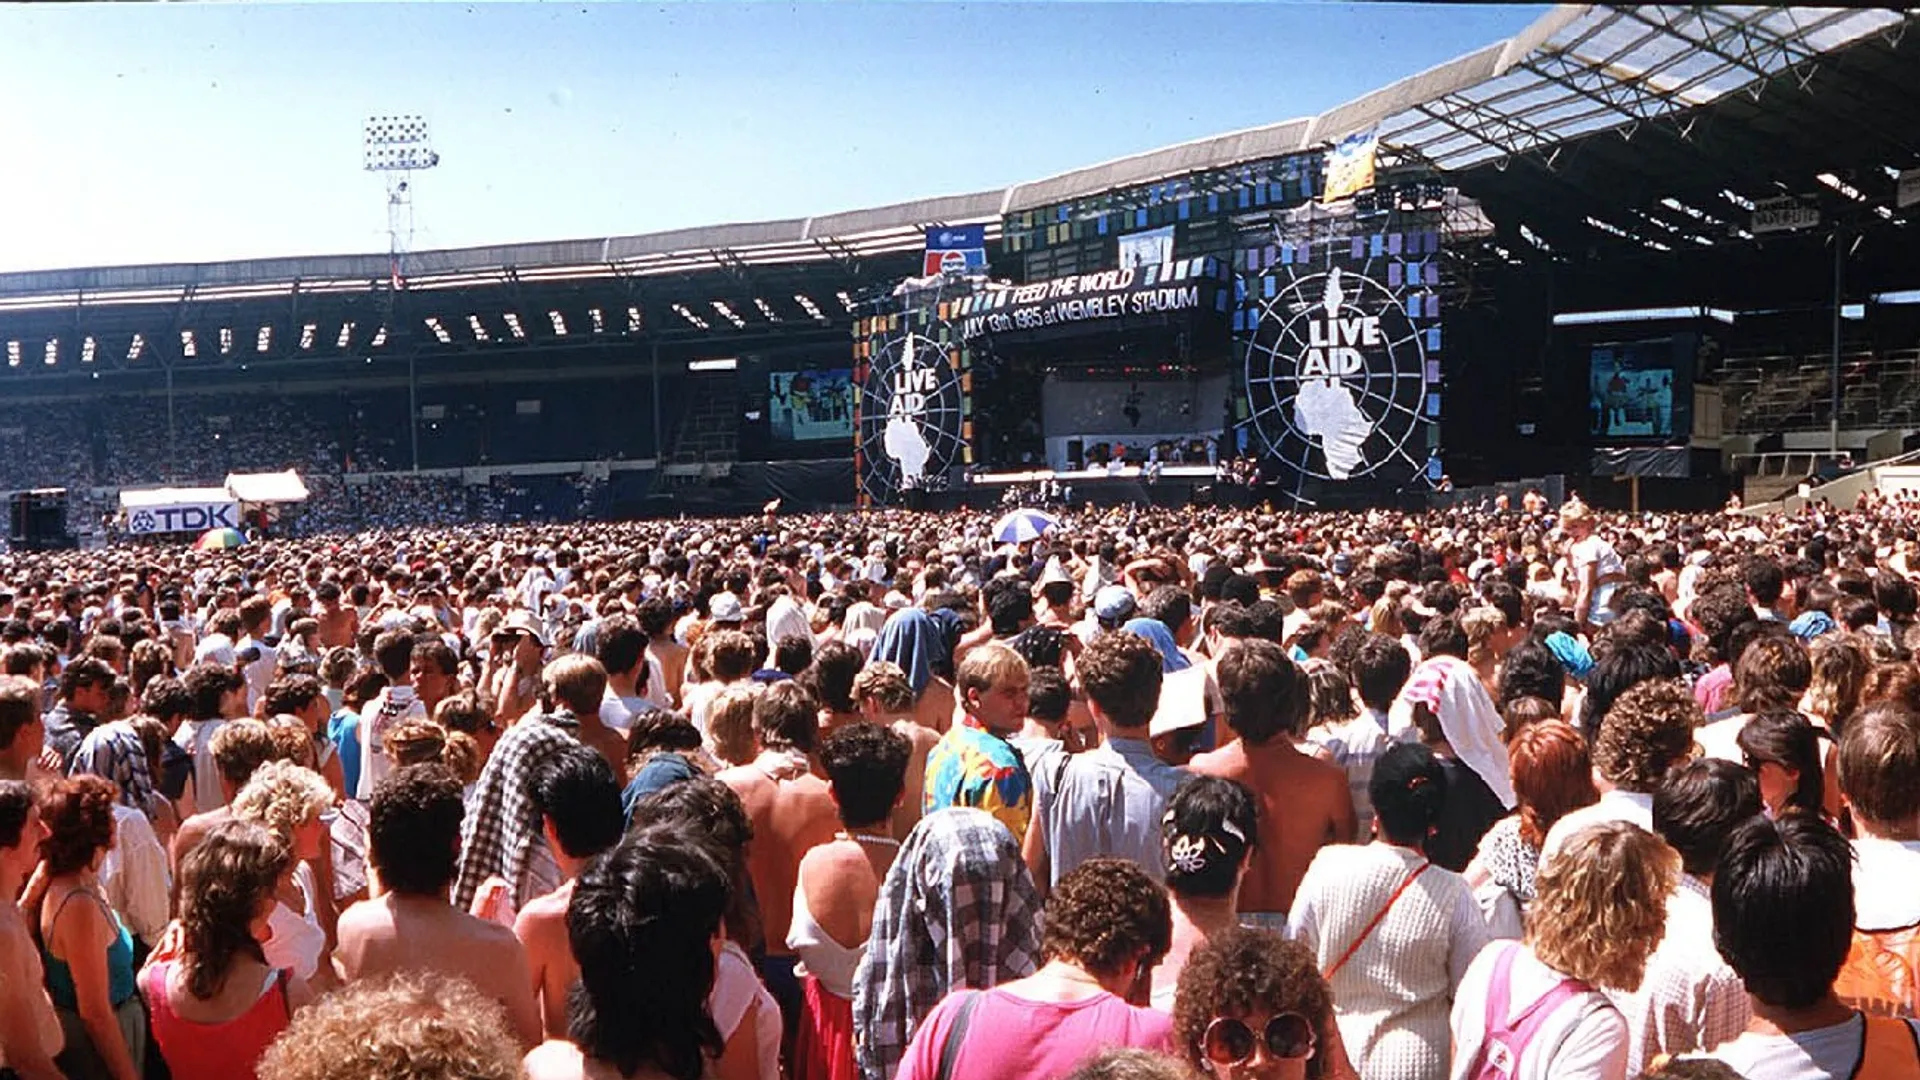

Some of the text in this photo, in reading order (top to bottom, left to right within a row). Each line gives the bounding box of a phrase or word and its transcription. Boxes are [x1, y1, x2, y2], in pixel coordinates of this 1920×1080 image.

[1011, 268, 1135, 303] FEED THE WORLD
[963, 285, 1199, 339] JULY 13th 1985 at WEMBLEY STADIUM
[1309, 316, 1380, 347] LIVE
[1303, 348, 1362, 375] AID
[895, 369, 935, 392] LIVE
[889, 392, 924, 415] AID
[155, 504, 234, 530] TDK
